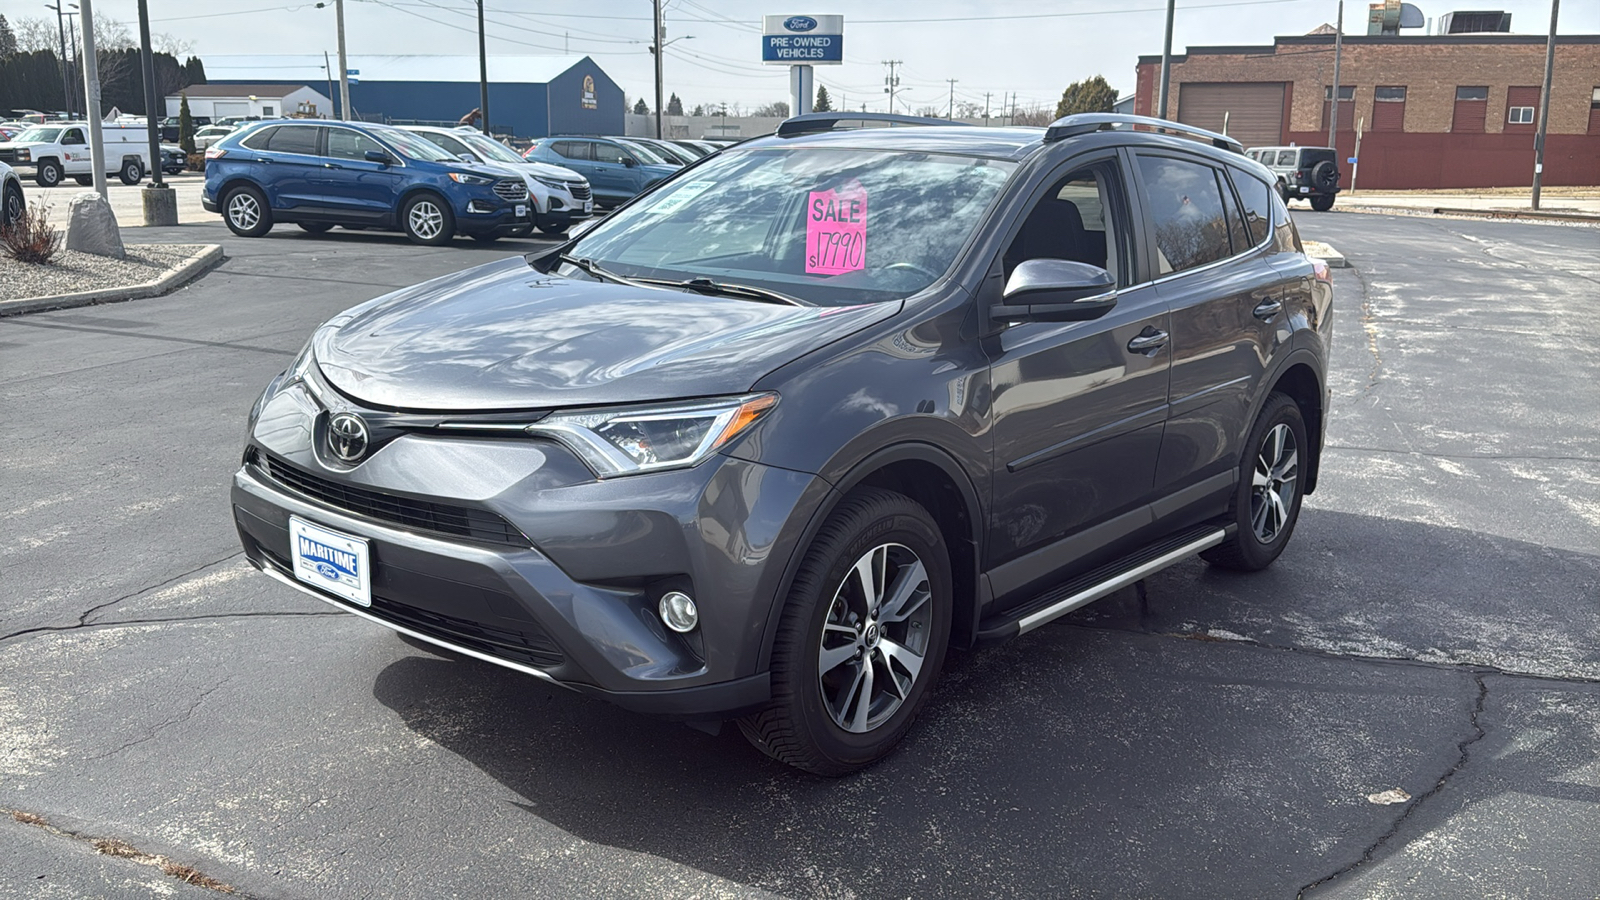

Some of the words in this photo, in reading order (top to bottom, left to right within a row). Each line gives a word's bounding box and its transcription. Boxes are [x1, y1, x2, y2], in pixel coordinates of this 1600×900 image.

[789, 19, 810, 29] Ford
[770, 37, 831, 47] PRE-OWNED
[776, 48, 824, 58] VEHICLES
[812, 198, 861, 223] SALE
[809, 231, 863, 269] $17990
[849, 518, 894, 557] MICHELIN
[299, 536, 358, 576] MARITIME
[320, 563, 337, 579] Ford
